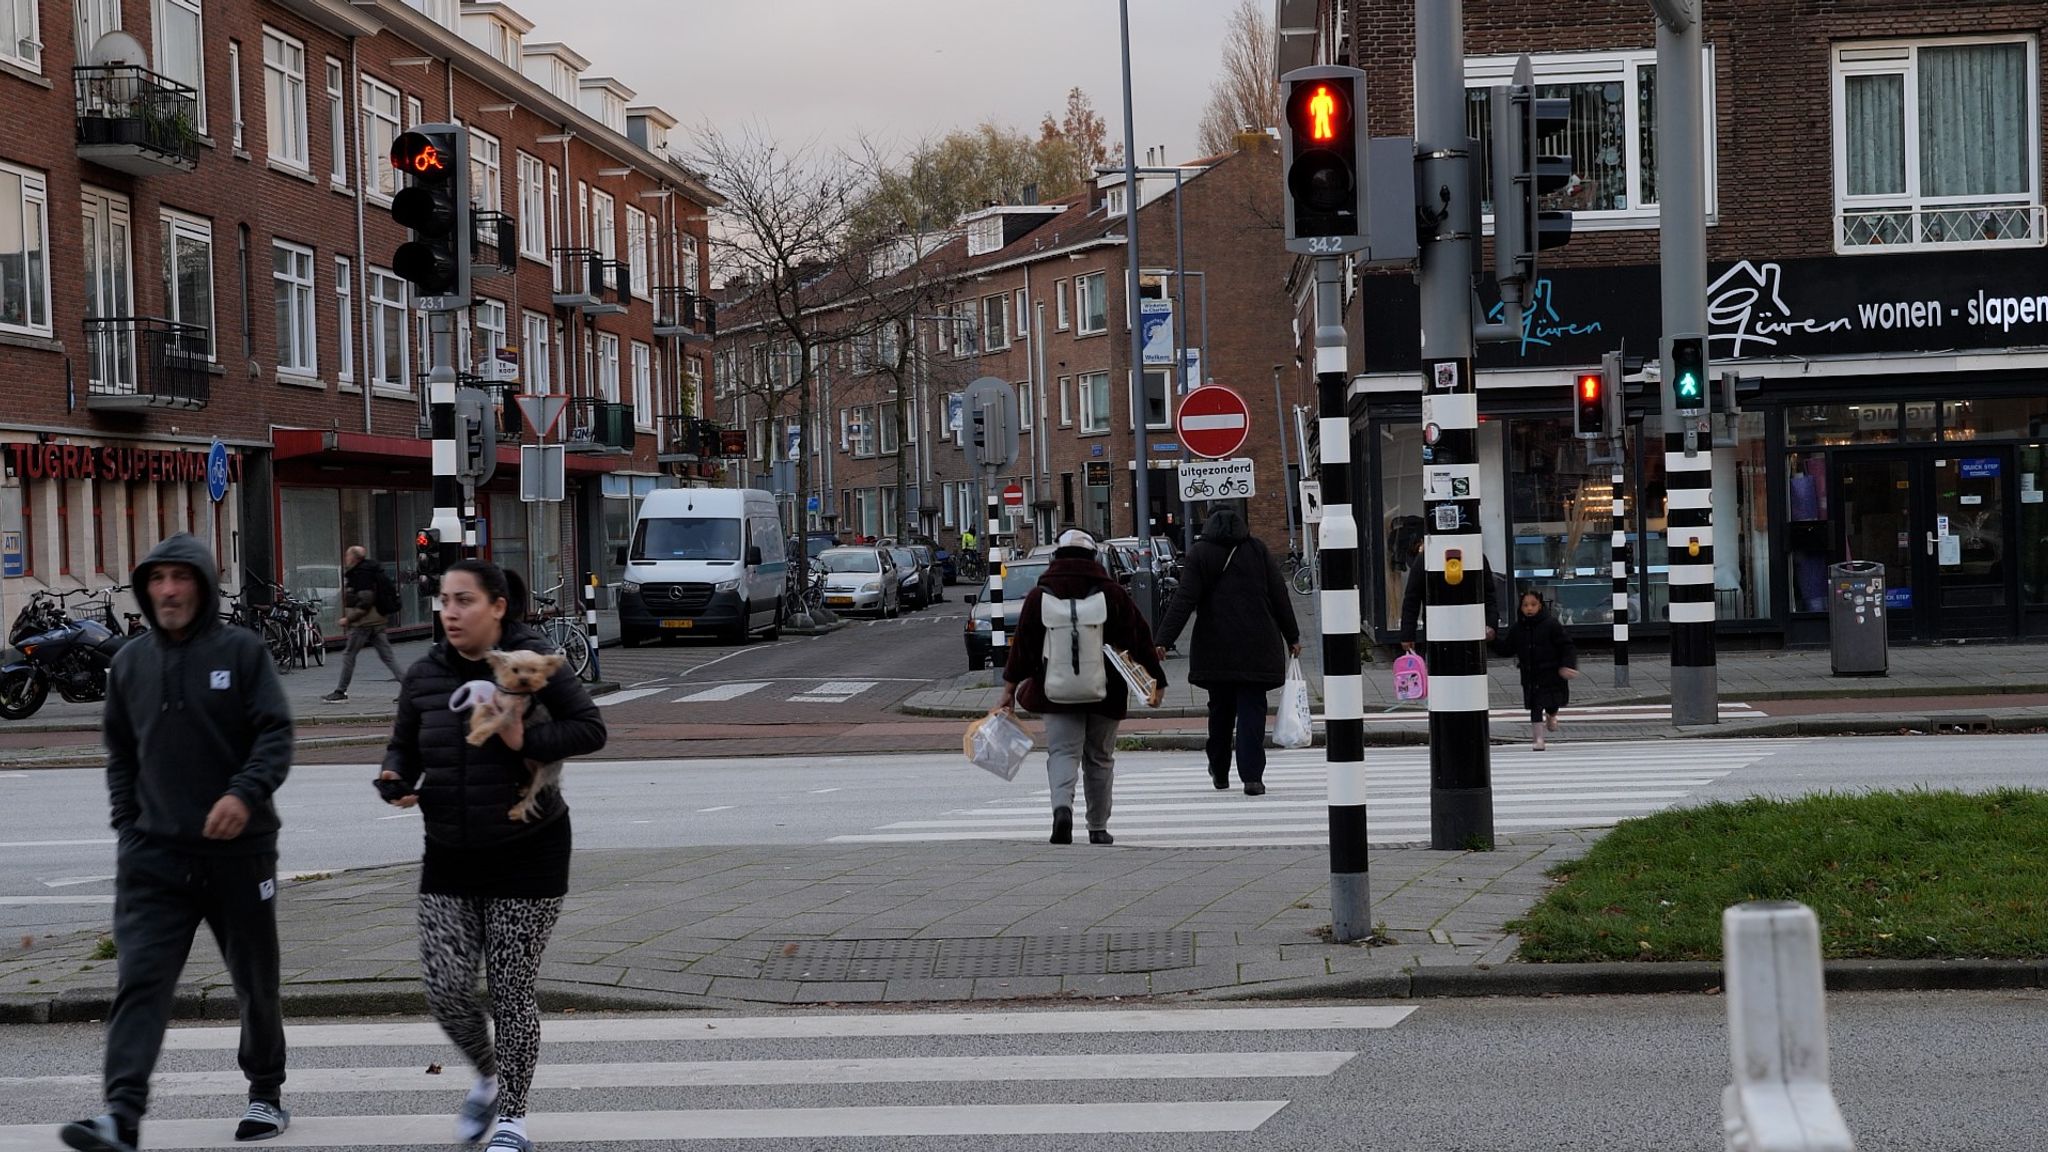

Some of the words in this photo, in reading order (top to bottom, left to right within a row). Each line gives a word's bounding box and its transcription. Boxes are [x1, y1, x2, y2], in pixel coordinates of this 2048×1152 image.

[1308, 236, 1343, 253] 34.2
[420, 296, 445, 309] 23.1
[1857, 300, 1943, 330] wonen
[1967, 288, 2048, 333] slapen
[101, 446, 244, 482] SUPERMAKT
[1180, 463, 1251, 478] uitgezonderd
